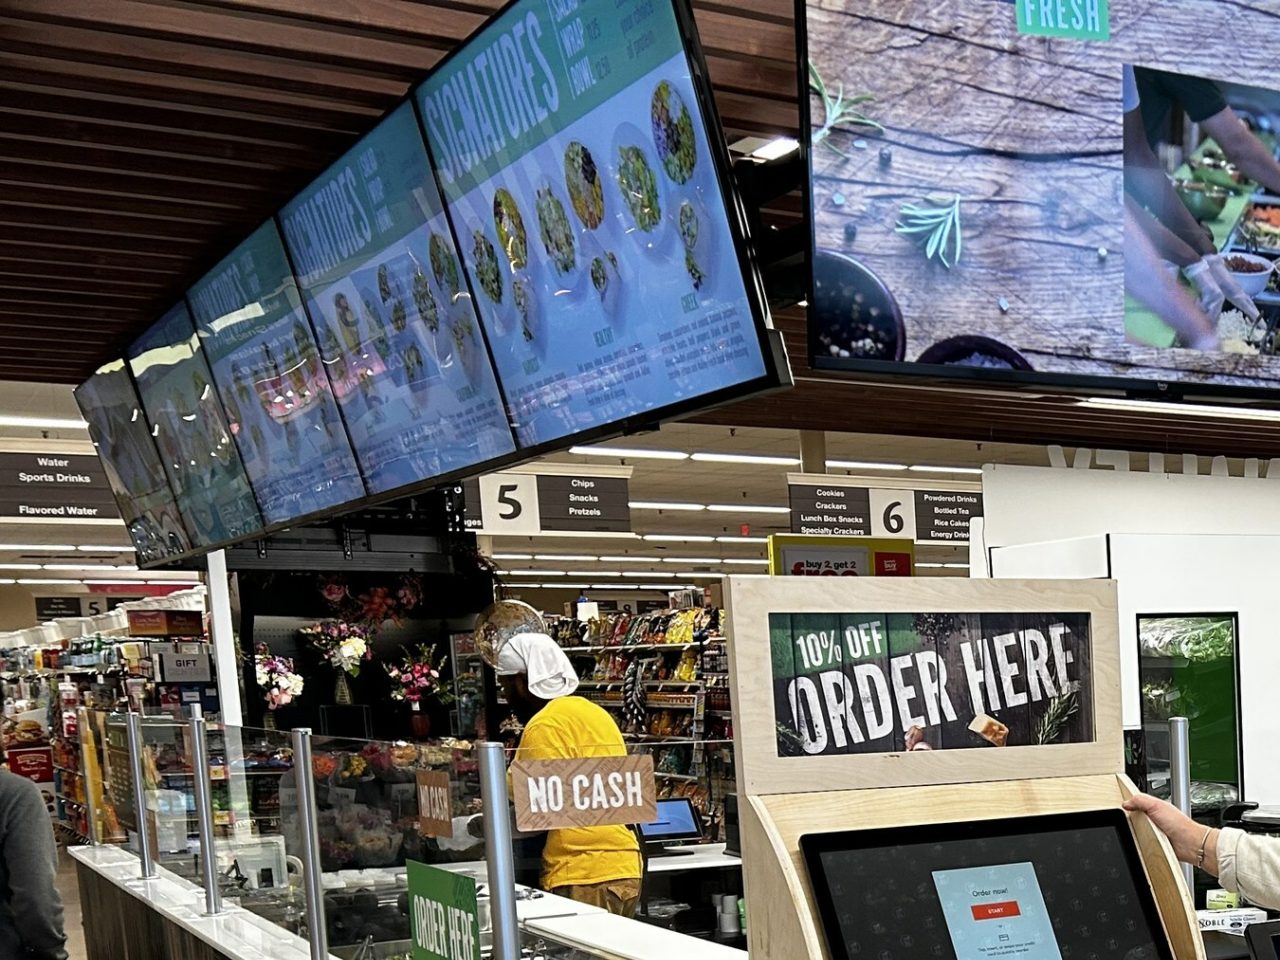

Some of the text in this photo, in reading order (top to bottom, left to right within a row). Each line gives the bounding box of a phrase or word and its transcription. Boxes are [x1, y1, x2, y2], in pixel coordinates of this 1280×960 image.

[1024, 0, 1099, 32] FRESH
[424, 10, 560, 184] SIGNATURES
[37, 457, 69, 467] Water
[19, 472, 91, 483] Sports Drinks
[571, 479, 595, 489] Chips
[569, 493, 599, 502] Snacks
[816, 489, 845, 497] Cookies
[497, 484, 522, 520] 5
[924, 494, 978, 503] Powdered Drinks
[19, 505, 98, 516] Flavored Water
[815, 502, 847, 510] Crackers
[934, 506, 970, 515] Bottled Tea
[568, 507, 601, 516] Pretzels
[801, 514, 822, 522] Lunch
[823, 515, 837, 523] Box
[883, 501, 904, 534] 6
[949, 519, 969, 527] Cakes
[801, 526, 864, 535] Specialty Crackers
[930, 530, 953, 539] Energy
[806, 560, 823, 569] buy
[833, 561, 848, 569] get
[796, 620, 883, 669] 10% OFF
[787, 622, 1078, 755] ORDER HERE
[527, 771, 643, 813] NO CASH
[972, 889, 991, 897] Order
[414, 894, 448, 958] ORDER
